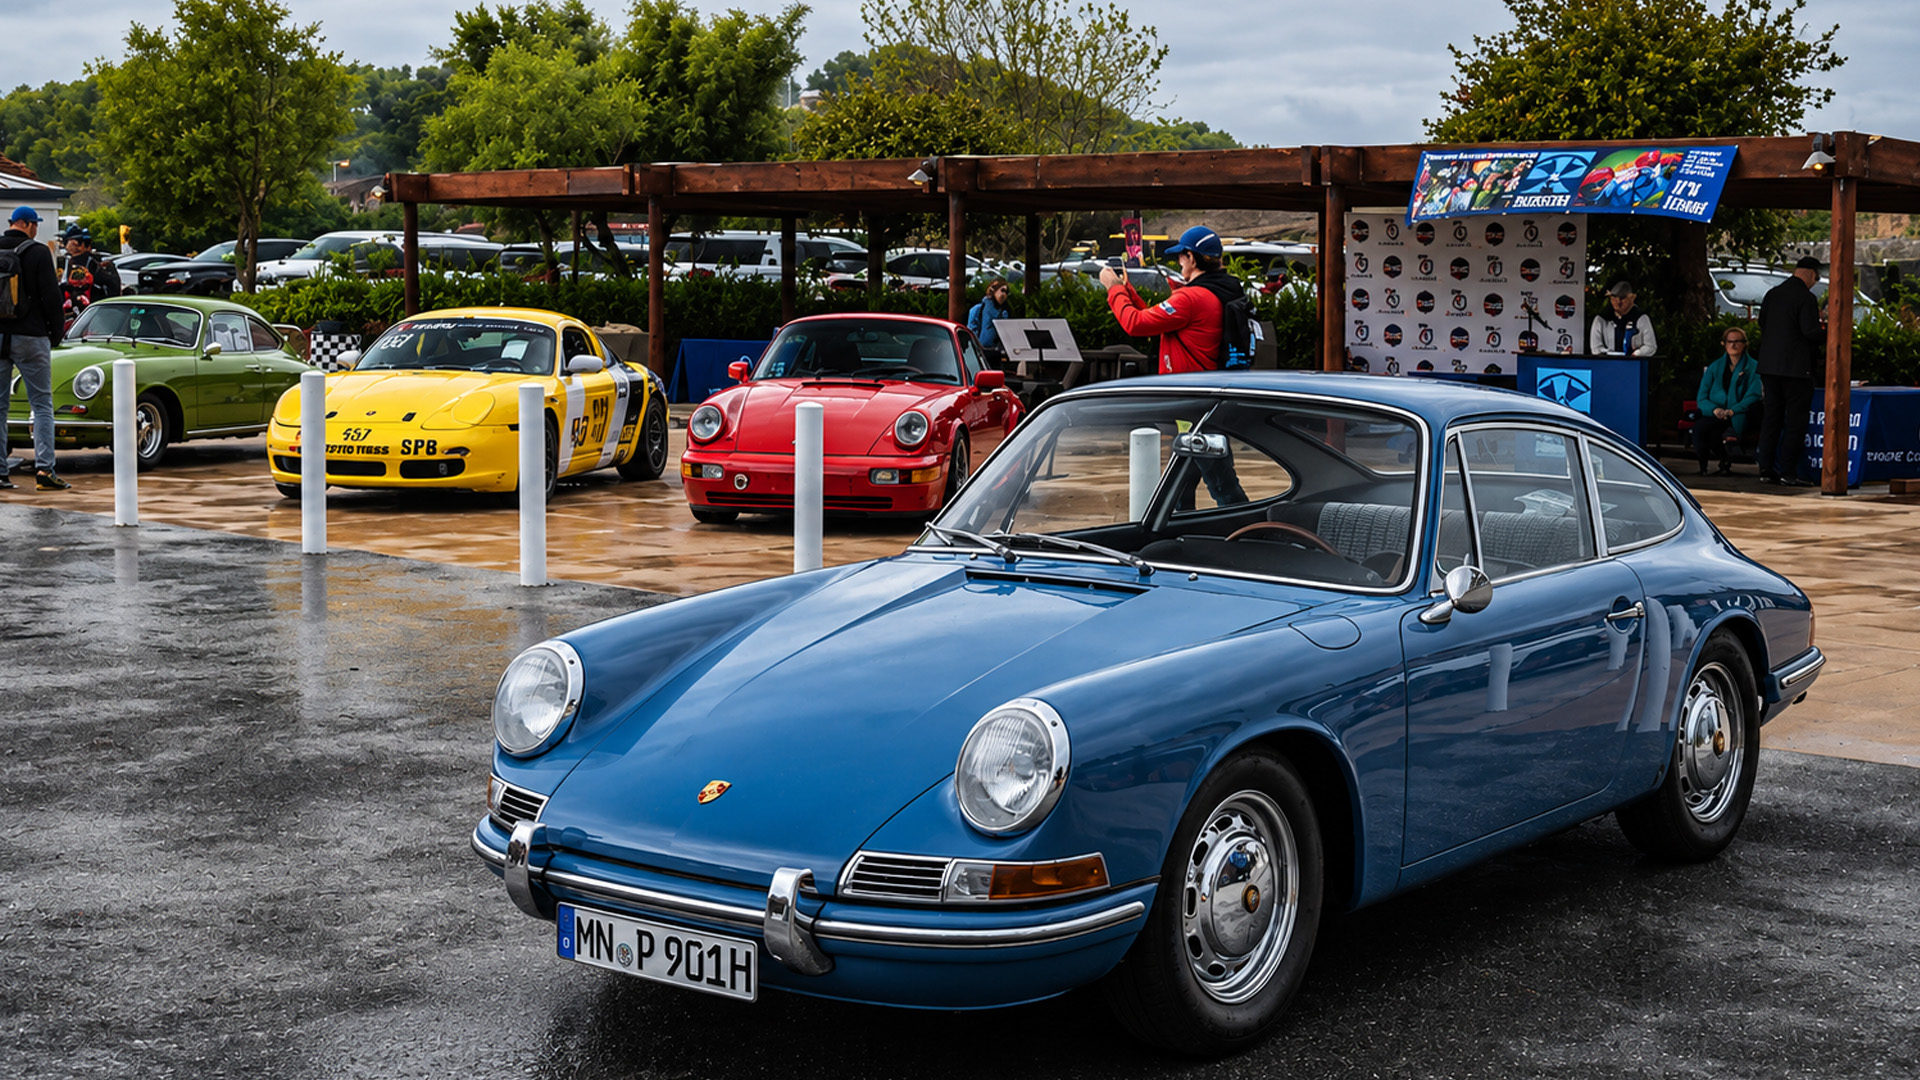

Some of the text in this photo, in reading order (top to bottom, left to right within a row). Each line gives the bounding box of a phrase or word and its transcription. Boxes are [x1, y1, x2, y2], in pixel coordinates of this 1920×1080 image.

[400, 439, 437, 455] SPB
[576, 916, 751, 993] MN P 901H
